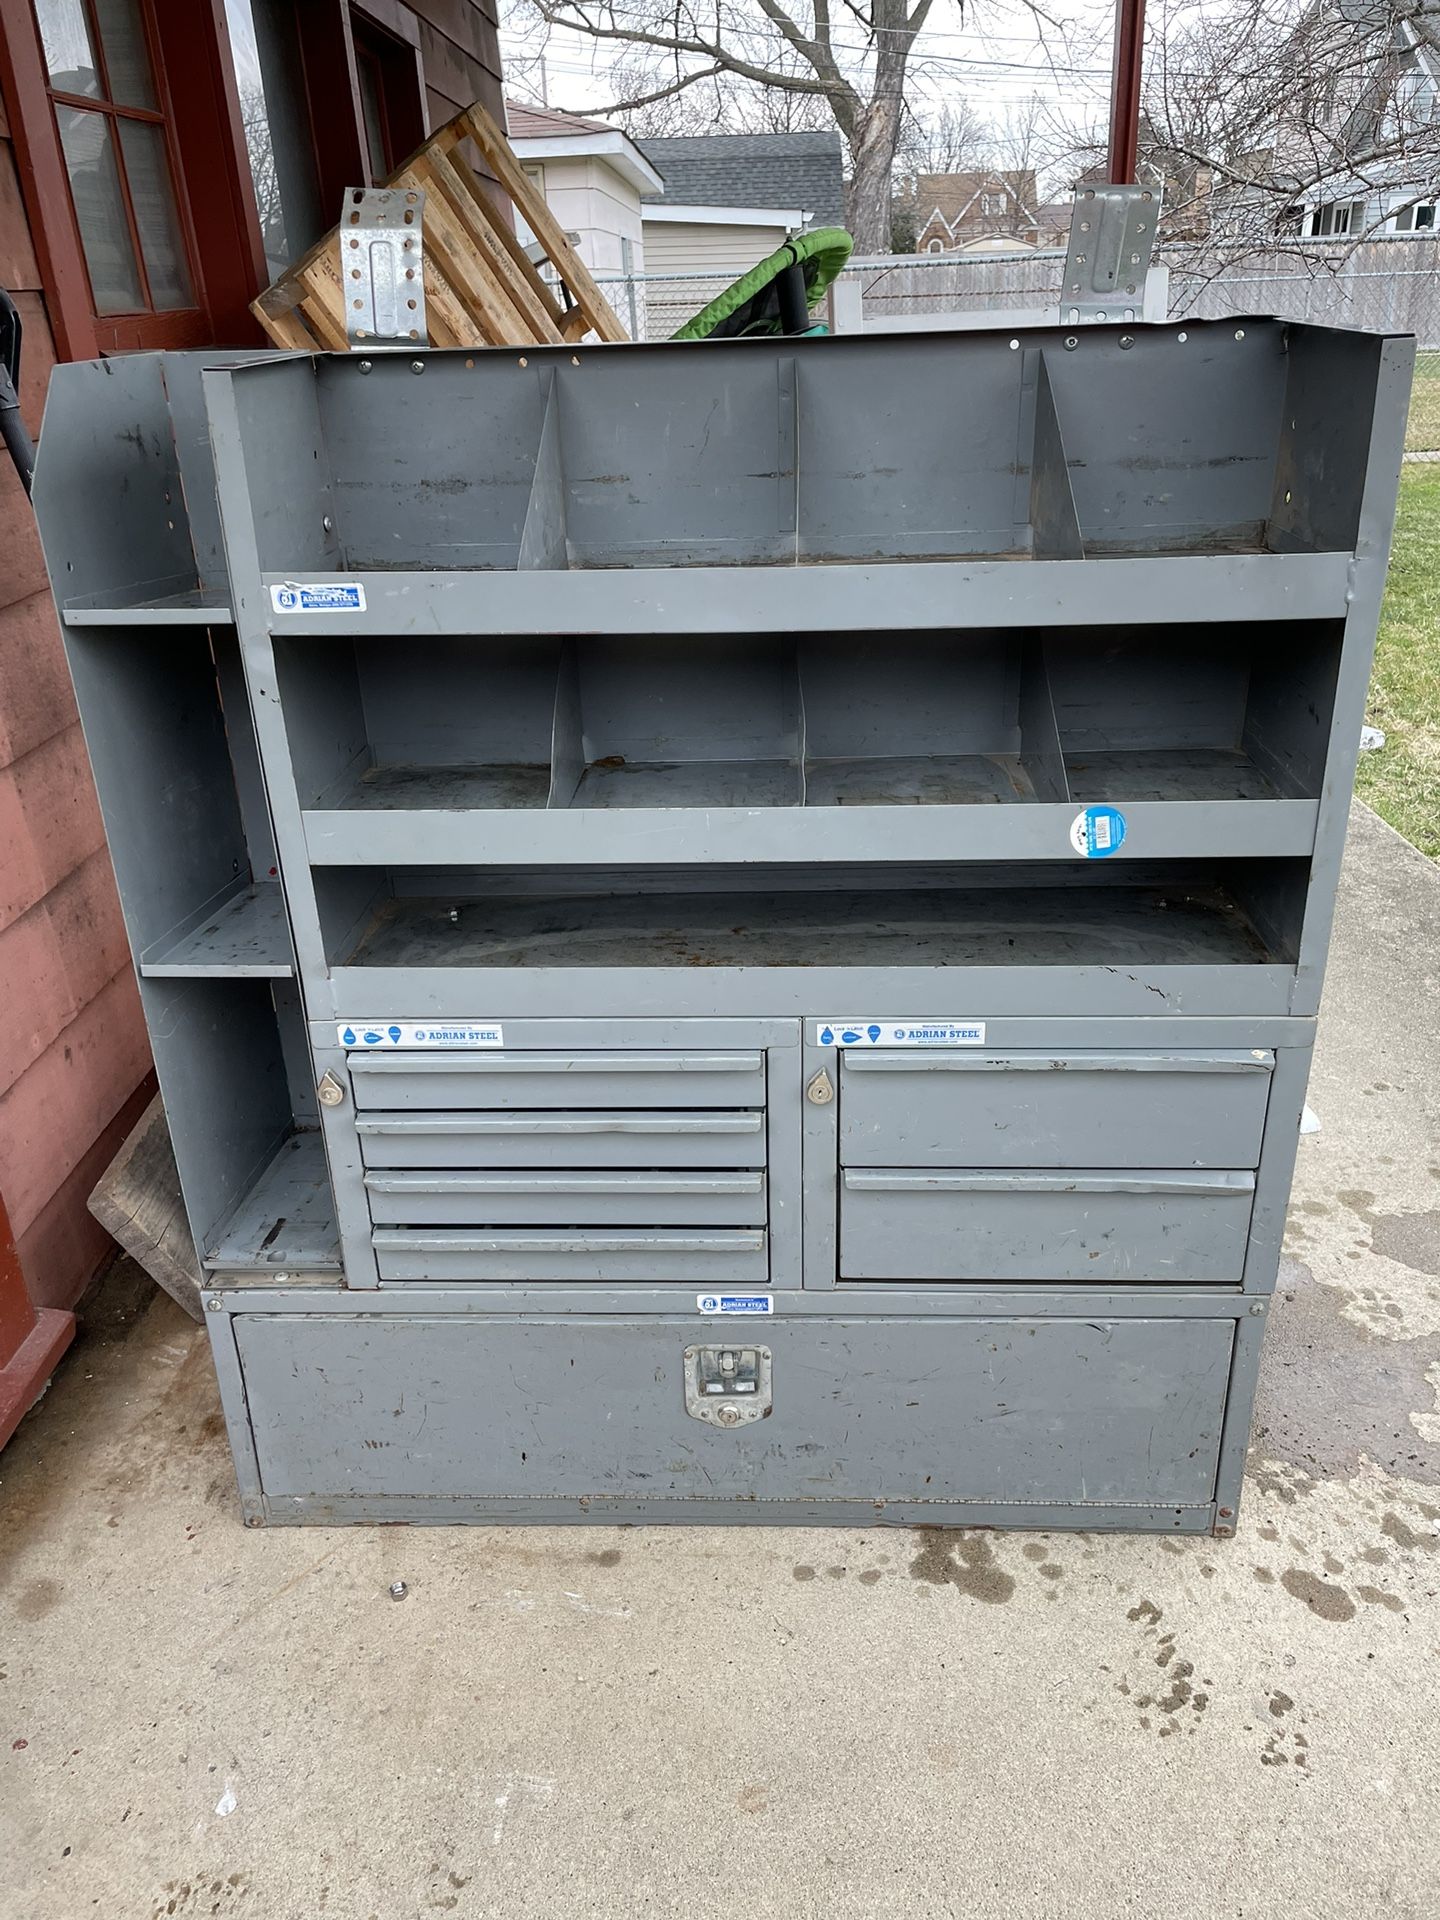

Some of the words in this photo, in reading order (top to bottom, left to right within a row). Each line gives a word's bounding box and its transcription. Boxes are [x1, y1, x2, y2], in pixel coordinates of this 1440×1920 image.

[334, 594, 358, 602] STEEL
[429, 1032, 466, 1040] ADRIAN
[468, 1032, 498, 1040] STEEL
[908, 1030, 947, 1038] ADRIAN
[949, 1030, 980, 1038] STEEL
